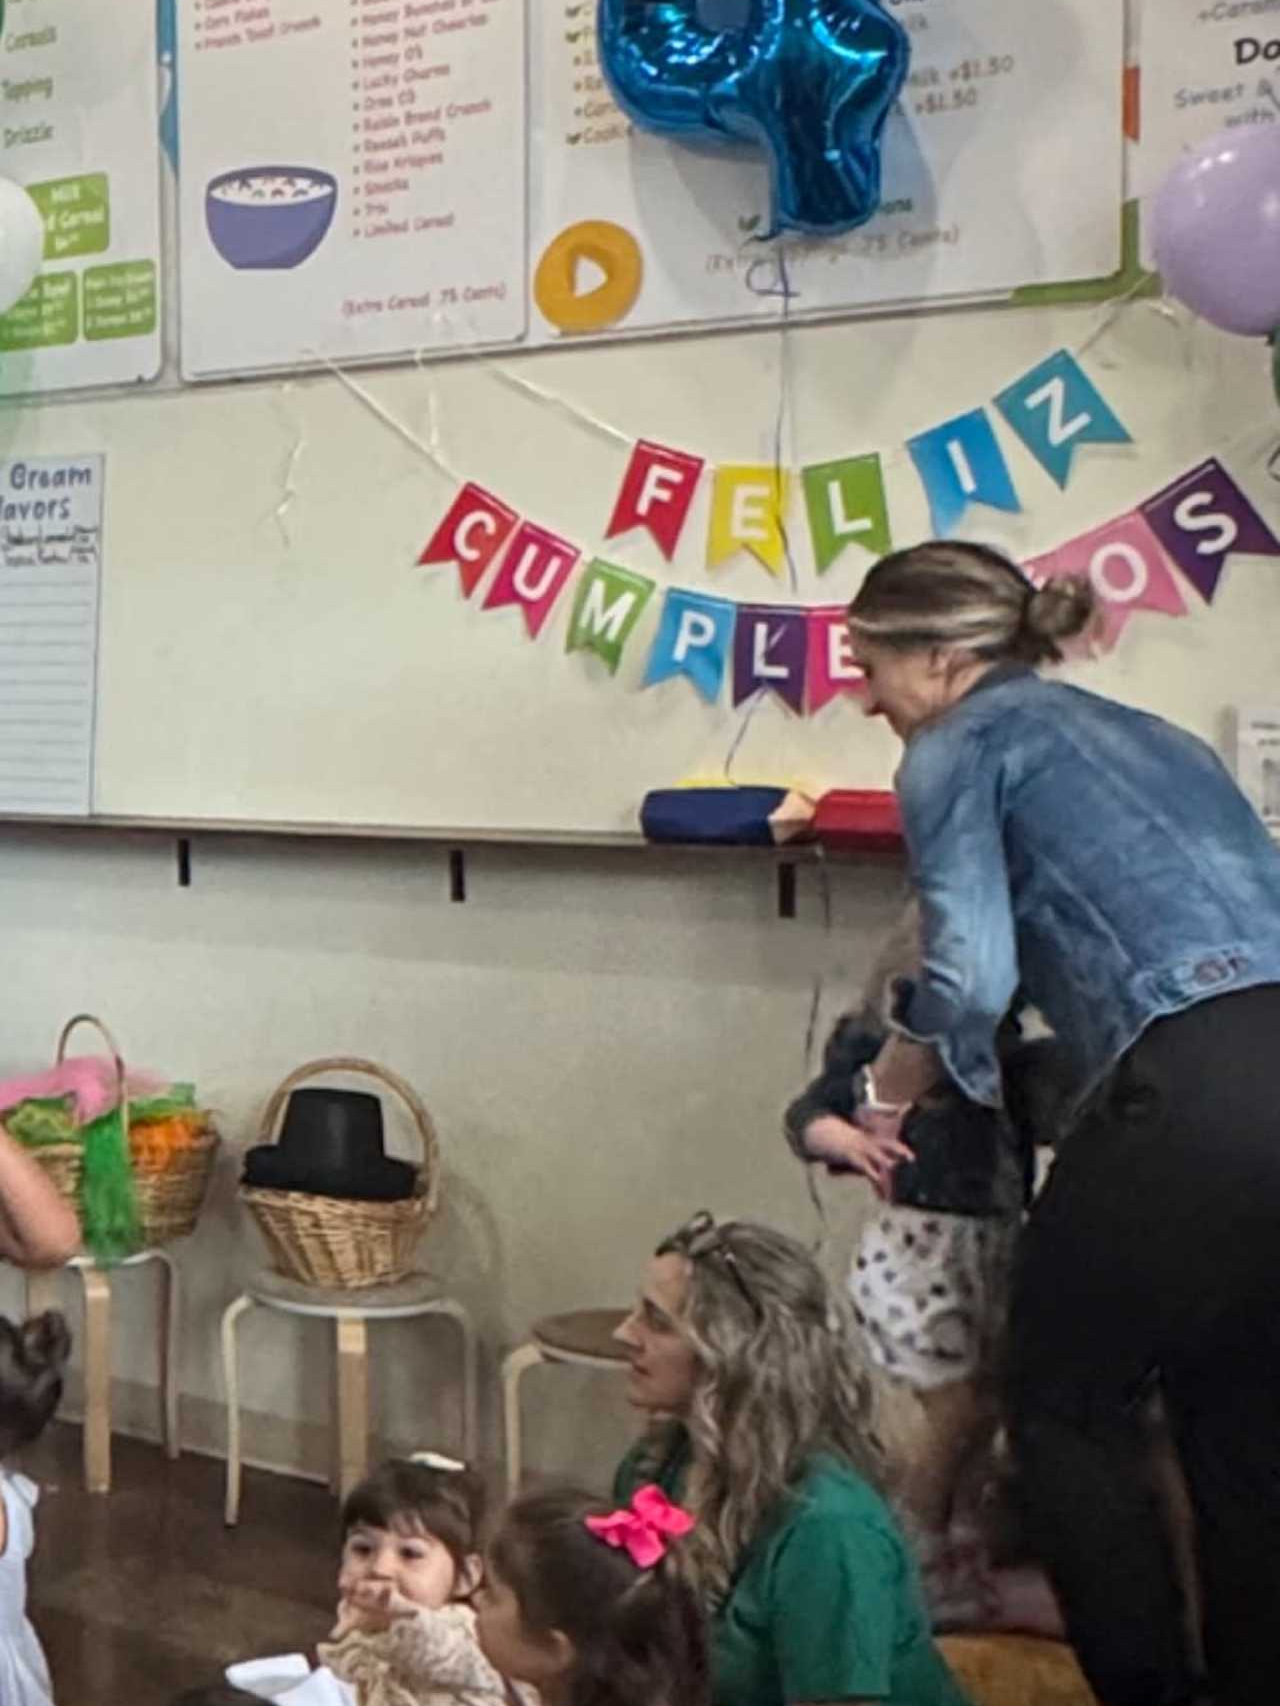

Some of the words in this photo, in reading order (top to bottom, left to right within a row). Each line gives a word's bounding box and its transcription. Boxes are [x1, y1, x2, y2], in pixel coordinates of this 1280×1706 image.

[1174, 82, 1245, 111] Sweet
[4, 123, 53, 145] Drizzle
[635, 375, 1090, 543] FELIZ
[10, 462, 92, 490] Cream
